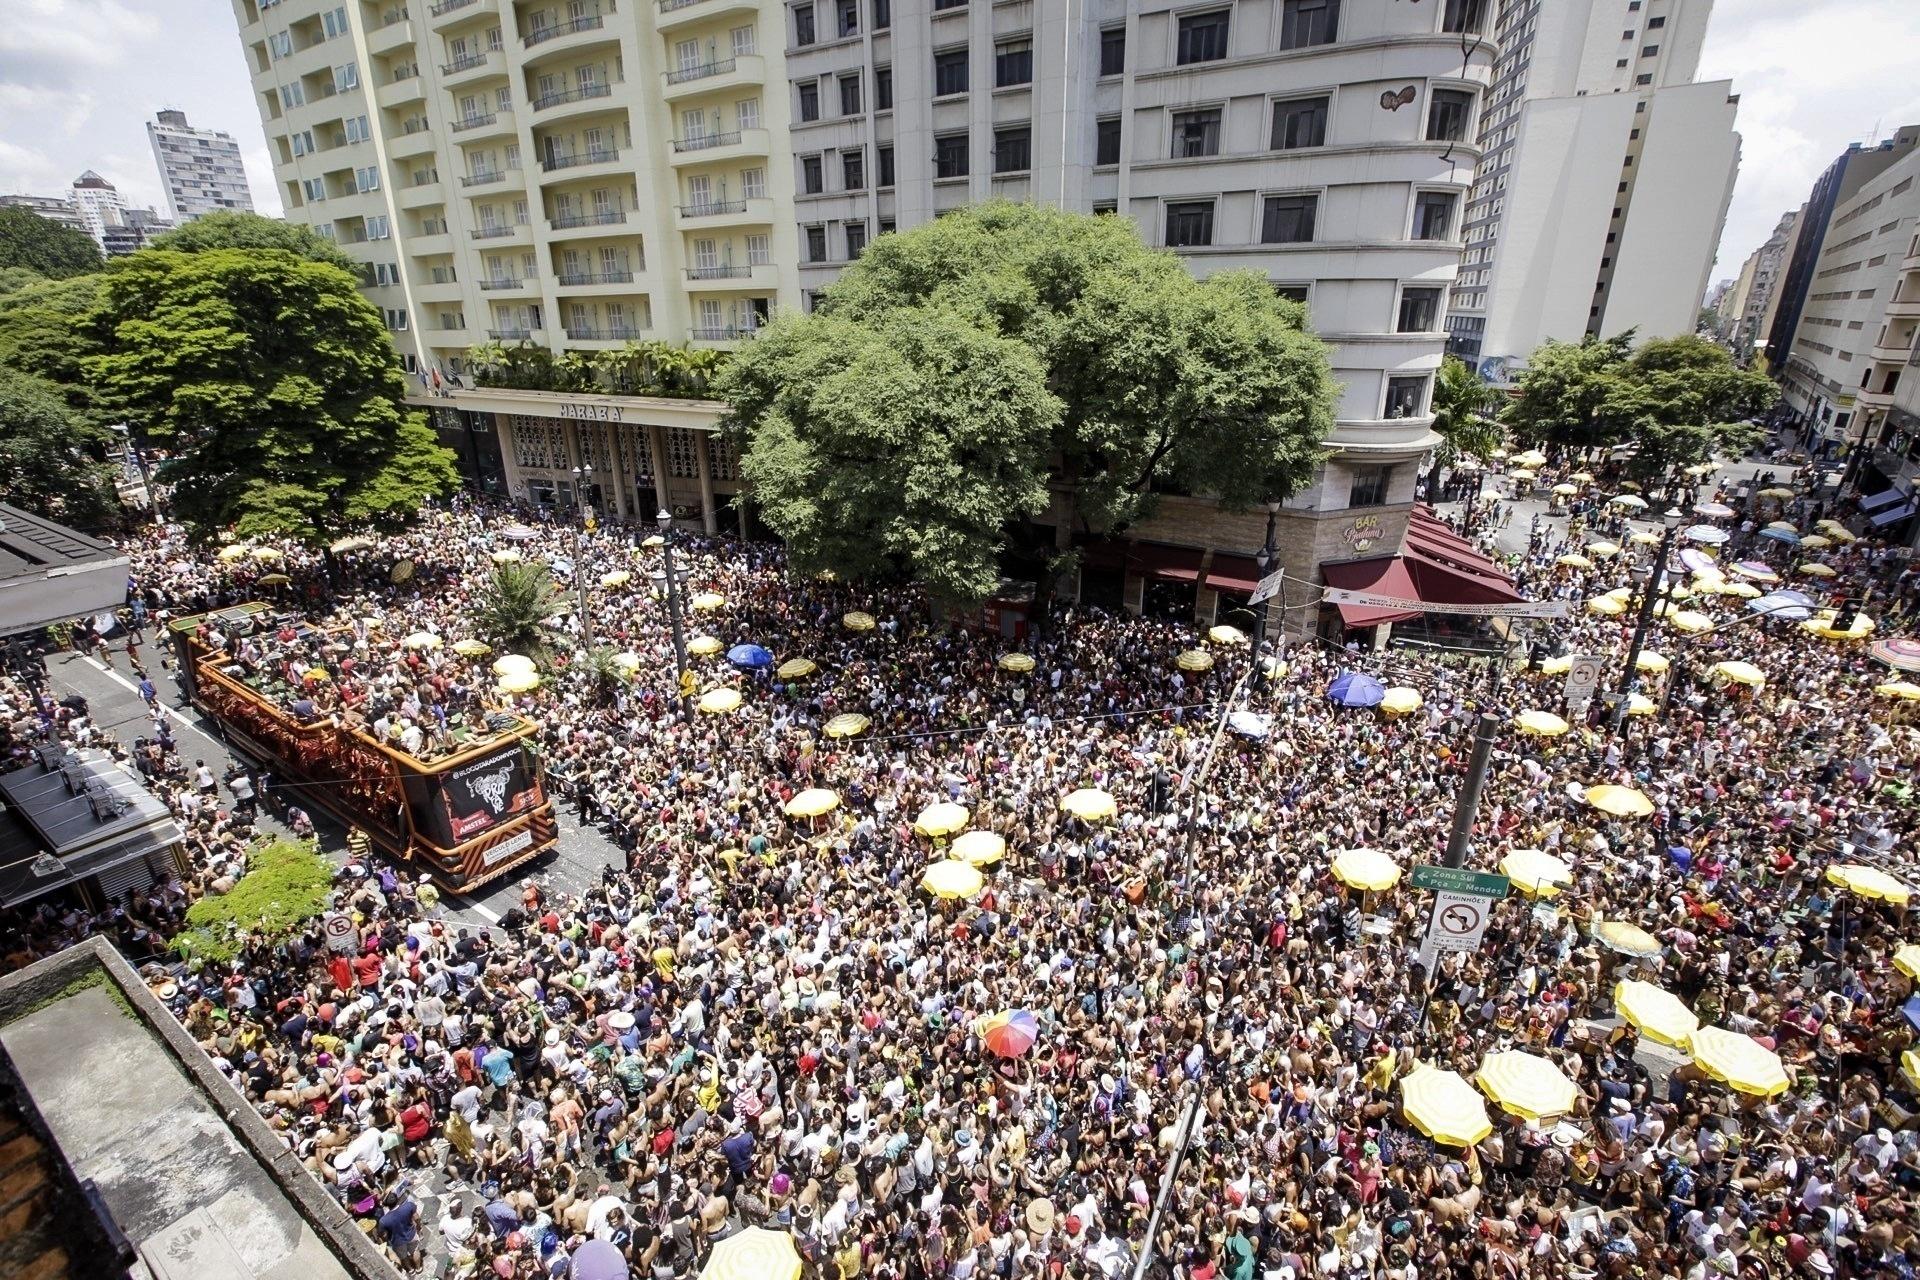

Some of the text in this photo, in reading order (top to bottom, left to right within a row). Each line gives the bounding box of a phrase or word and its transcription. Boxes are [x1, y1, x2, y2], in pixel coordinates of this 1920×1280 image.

[1356, 516, 1377, 529] BAR
[460, 818, 487, 834] AMSTEL
[1432, 870, 1475, 882] Zona Sul
[1466, 883, 1502, 894] Mendes
[1442, 894, 1486, 904] CAMINHÕES
